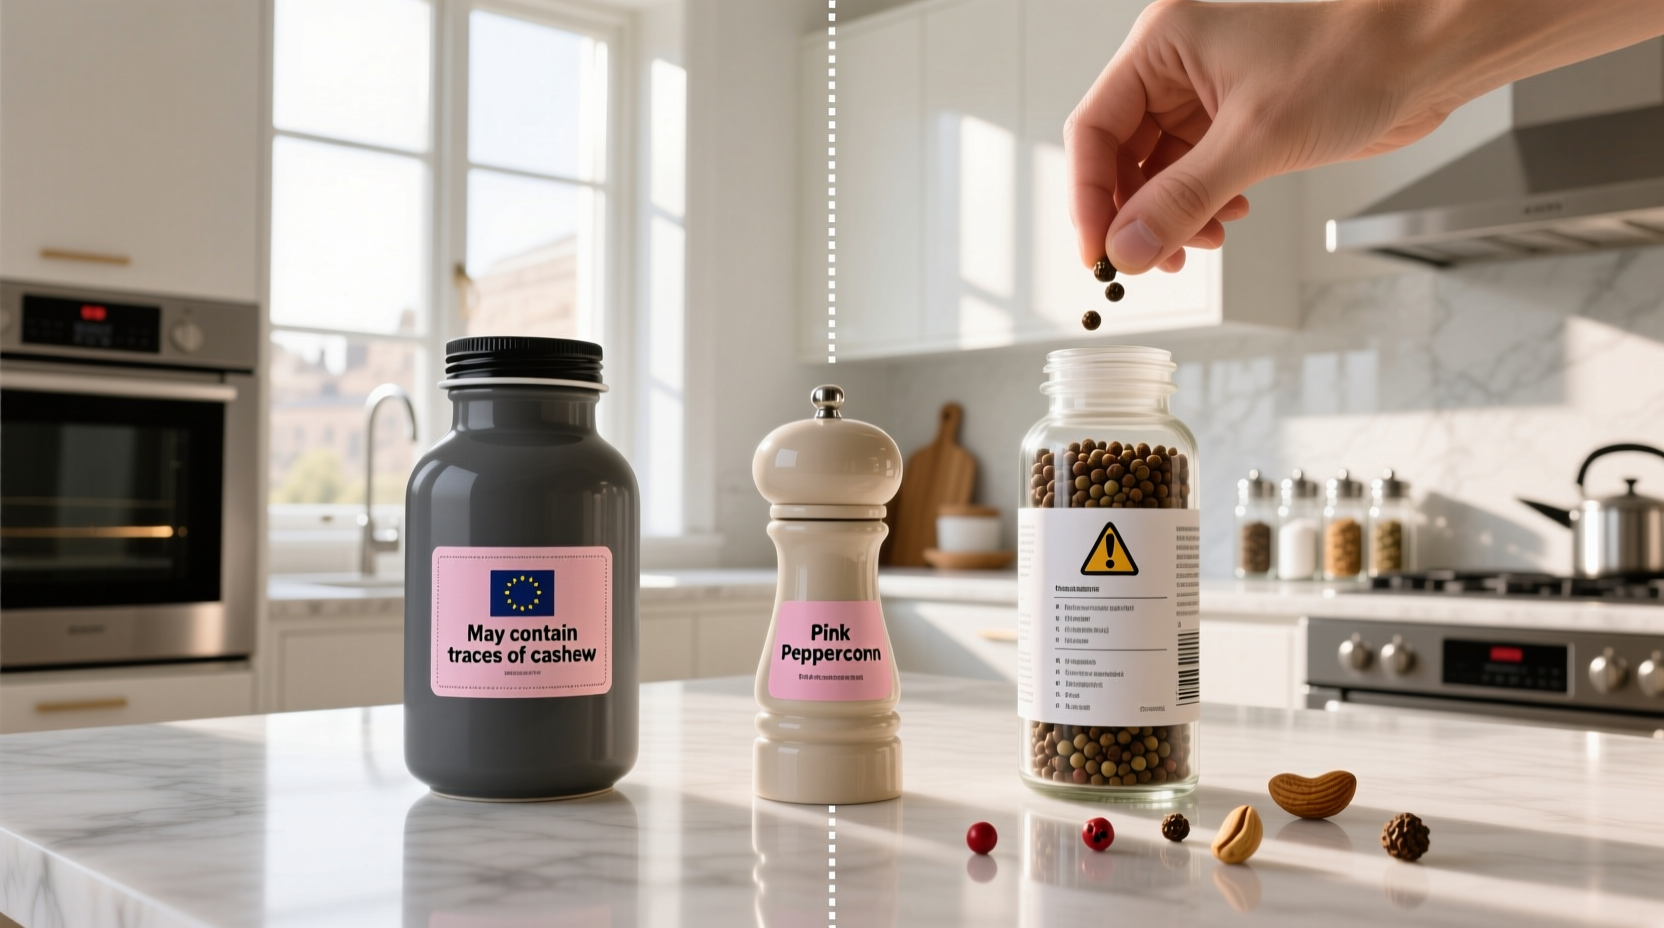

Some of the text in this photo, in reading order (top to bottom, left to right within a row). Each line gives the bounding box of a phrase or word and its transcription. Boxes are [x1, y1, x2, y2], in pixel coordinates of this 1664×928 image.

[468, 624, 577, 645] May contain
[811, 623, 851, 641] Pink
[448, 645, 596, 664] traces of cashew
